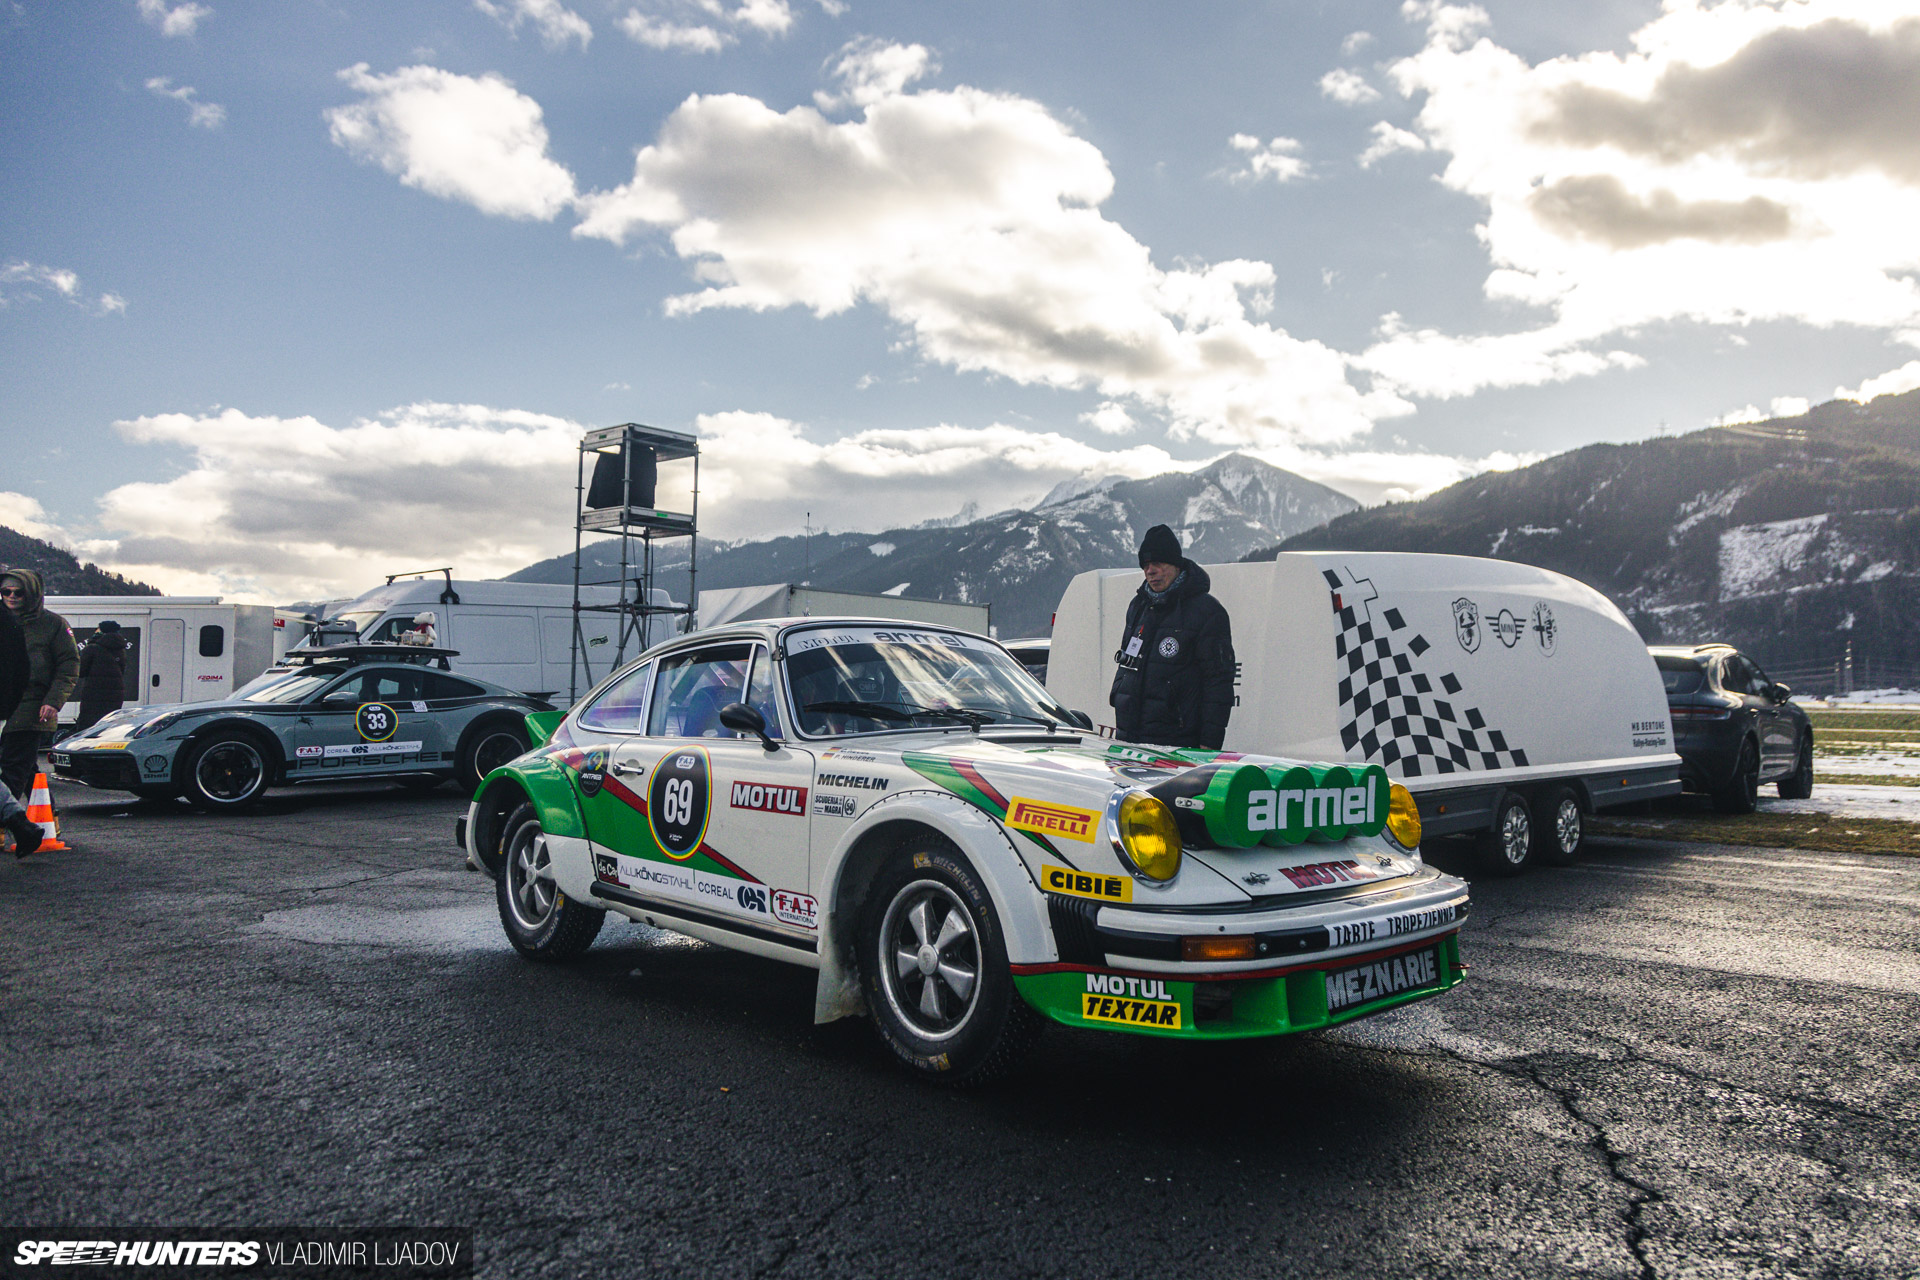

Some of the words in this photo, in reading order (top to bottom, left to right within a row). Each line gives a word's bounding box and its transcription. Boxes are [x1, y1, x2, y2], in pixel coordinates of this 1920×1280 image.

[873, 632, 967, 647] armel
[1500, 623, 1515, 633] MINI
[367, 713, 388, 730] 33
[299, 752, 438, 769] PORSCHE
[817, 773, 889, 791] MICHELIN
[663, 777, 694, 826] 69
[732, 783, 803, 814] MOTUL
[1247, 775, 1376, 832] armel
[1013, 802, 1091, 836] PIRELLI
[697, 881, 734, 900] CCREAL
[933, 855, 982, 901] MICHELIN
[779, 911, 815, 926] INTERNATIONAL
[1333, 920, 1376, 947] TARTE
[1086, 973, 1173, 1001] MOTUL
[1325, 949, 1437, 1010] MEZNARIE
[1086, 996, 1178, 1026] TEXTAR
